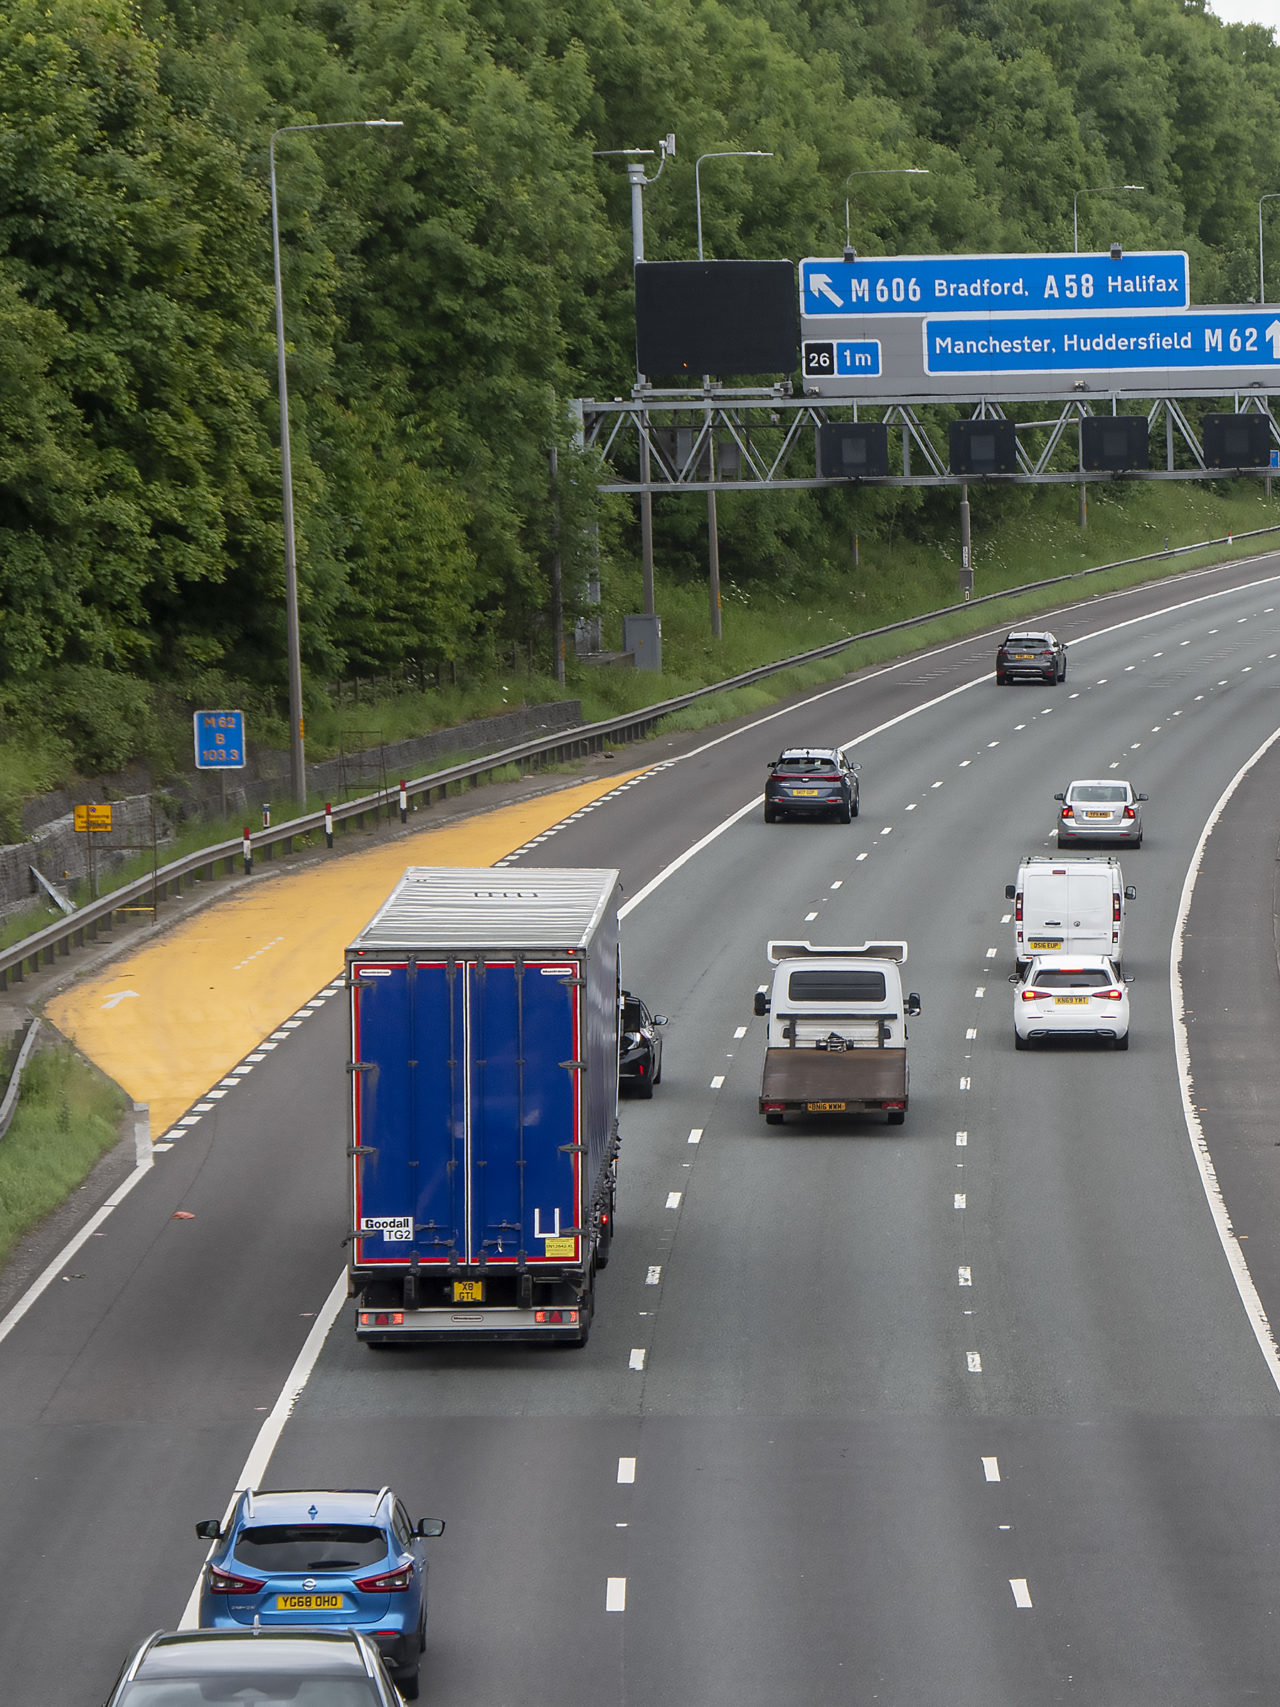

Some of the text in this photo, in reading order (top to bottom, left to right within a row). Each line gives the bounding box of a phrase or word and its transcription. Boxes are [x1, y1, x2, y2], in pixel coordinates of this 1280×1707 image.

[850, 273, 1179, 302] M606 Bradford, A58 Halifax
[935, 327, 1258, 354] Manchester, Huddersfield M62
[809, 352, 830, 367] 26
[215, 733, 226, 745] B
[202, 749, 239, 761] 103.3
[365, 1218, 410, 1229] Goodall
[386, 1230, 411, 1240] TG2
[462, 1283, 474, 1291] X8
[460, 1292, 474, 1300] GTL
[282, 1596, 338, 1607] YG68 OHO
